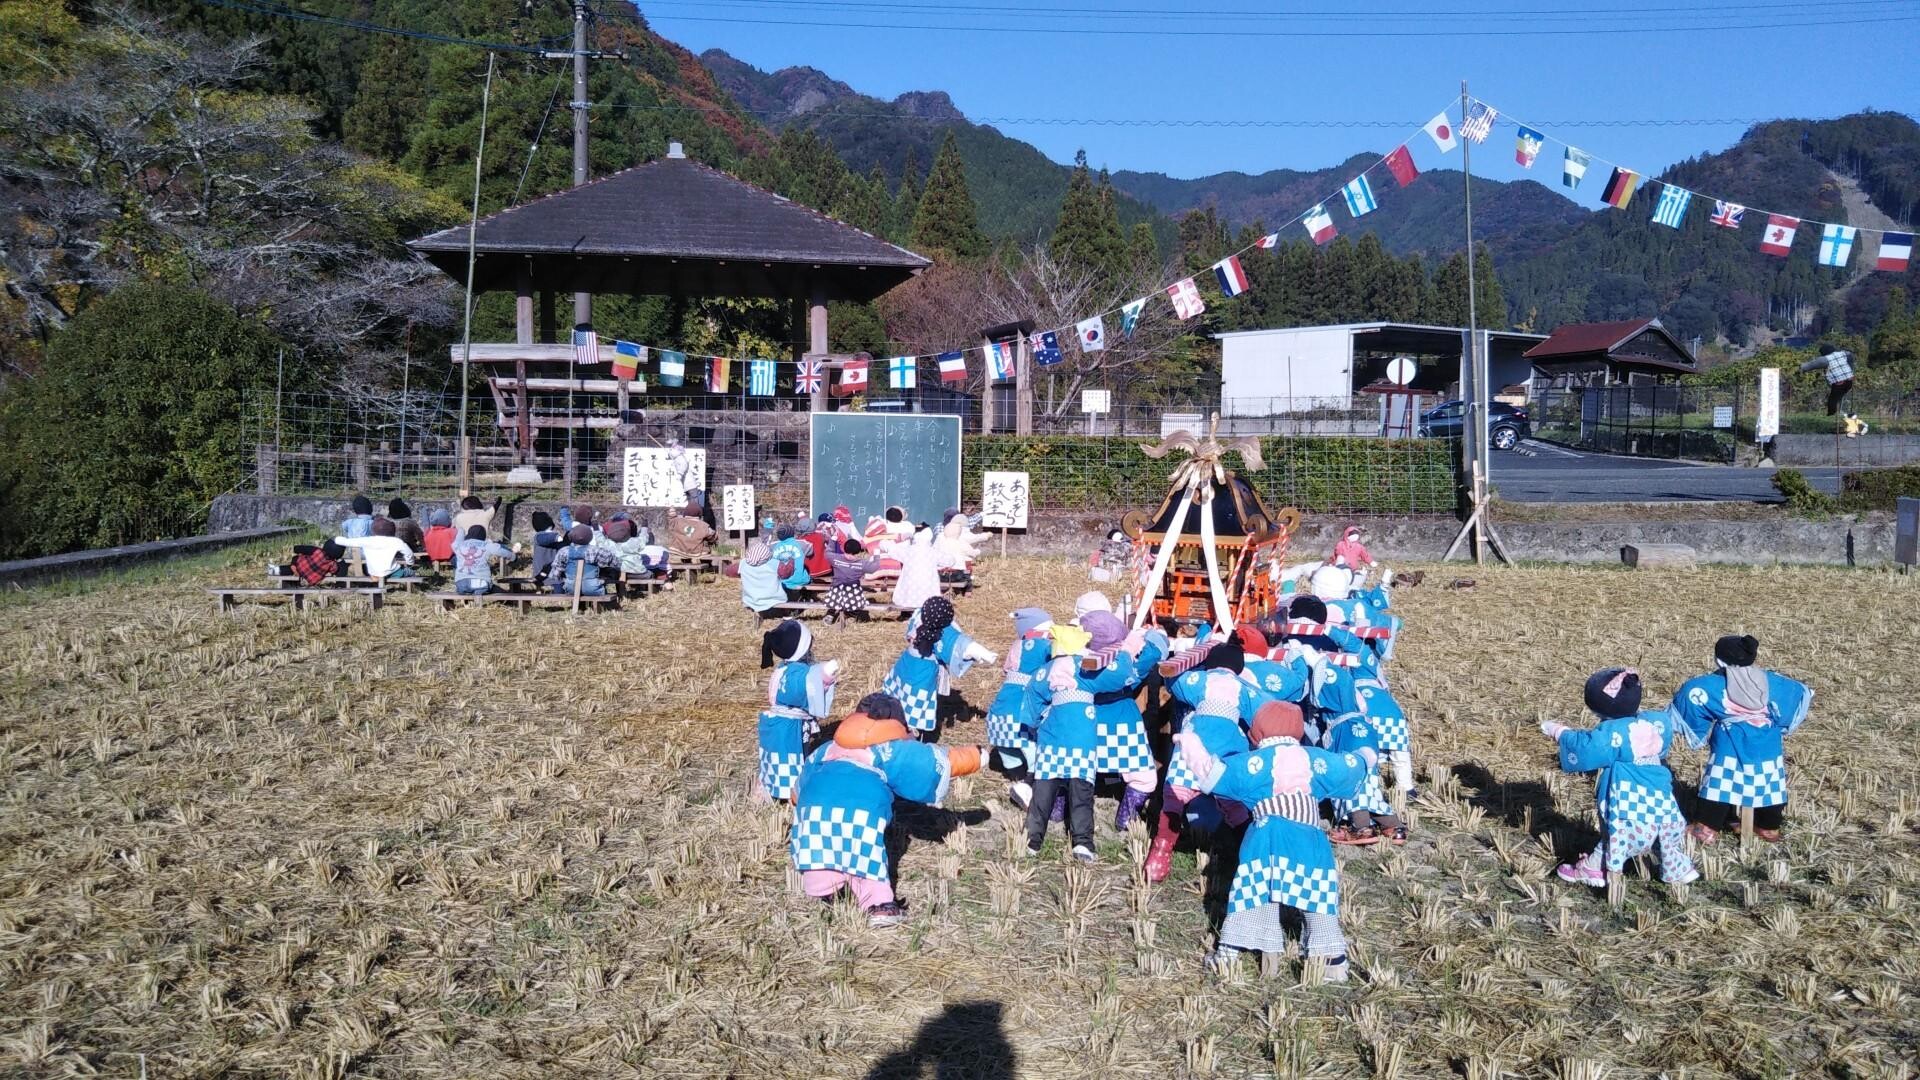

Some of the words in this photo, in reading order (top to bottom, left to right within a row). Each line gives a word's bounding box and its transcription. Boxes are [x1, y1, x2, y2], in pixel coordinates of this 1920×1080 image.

[626, 452, 644, 505] みてごらん
[650, 454, 660, 489] そっと
[726, 487, 737, 527] がっこう
[985, 481, 1010, 517] 教室
[1006, 479, 1027, 526] あおぞら
